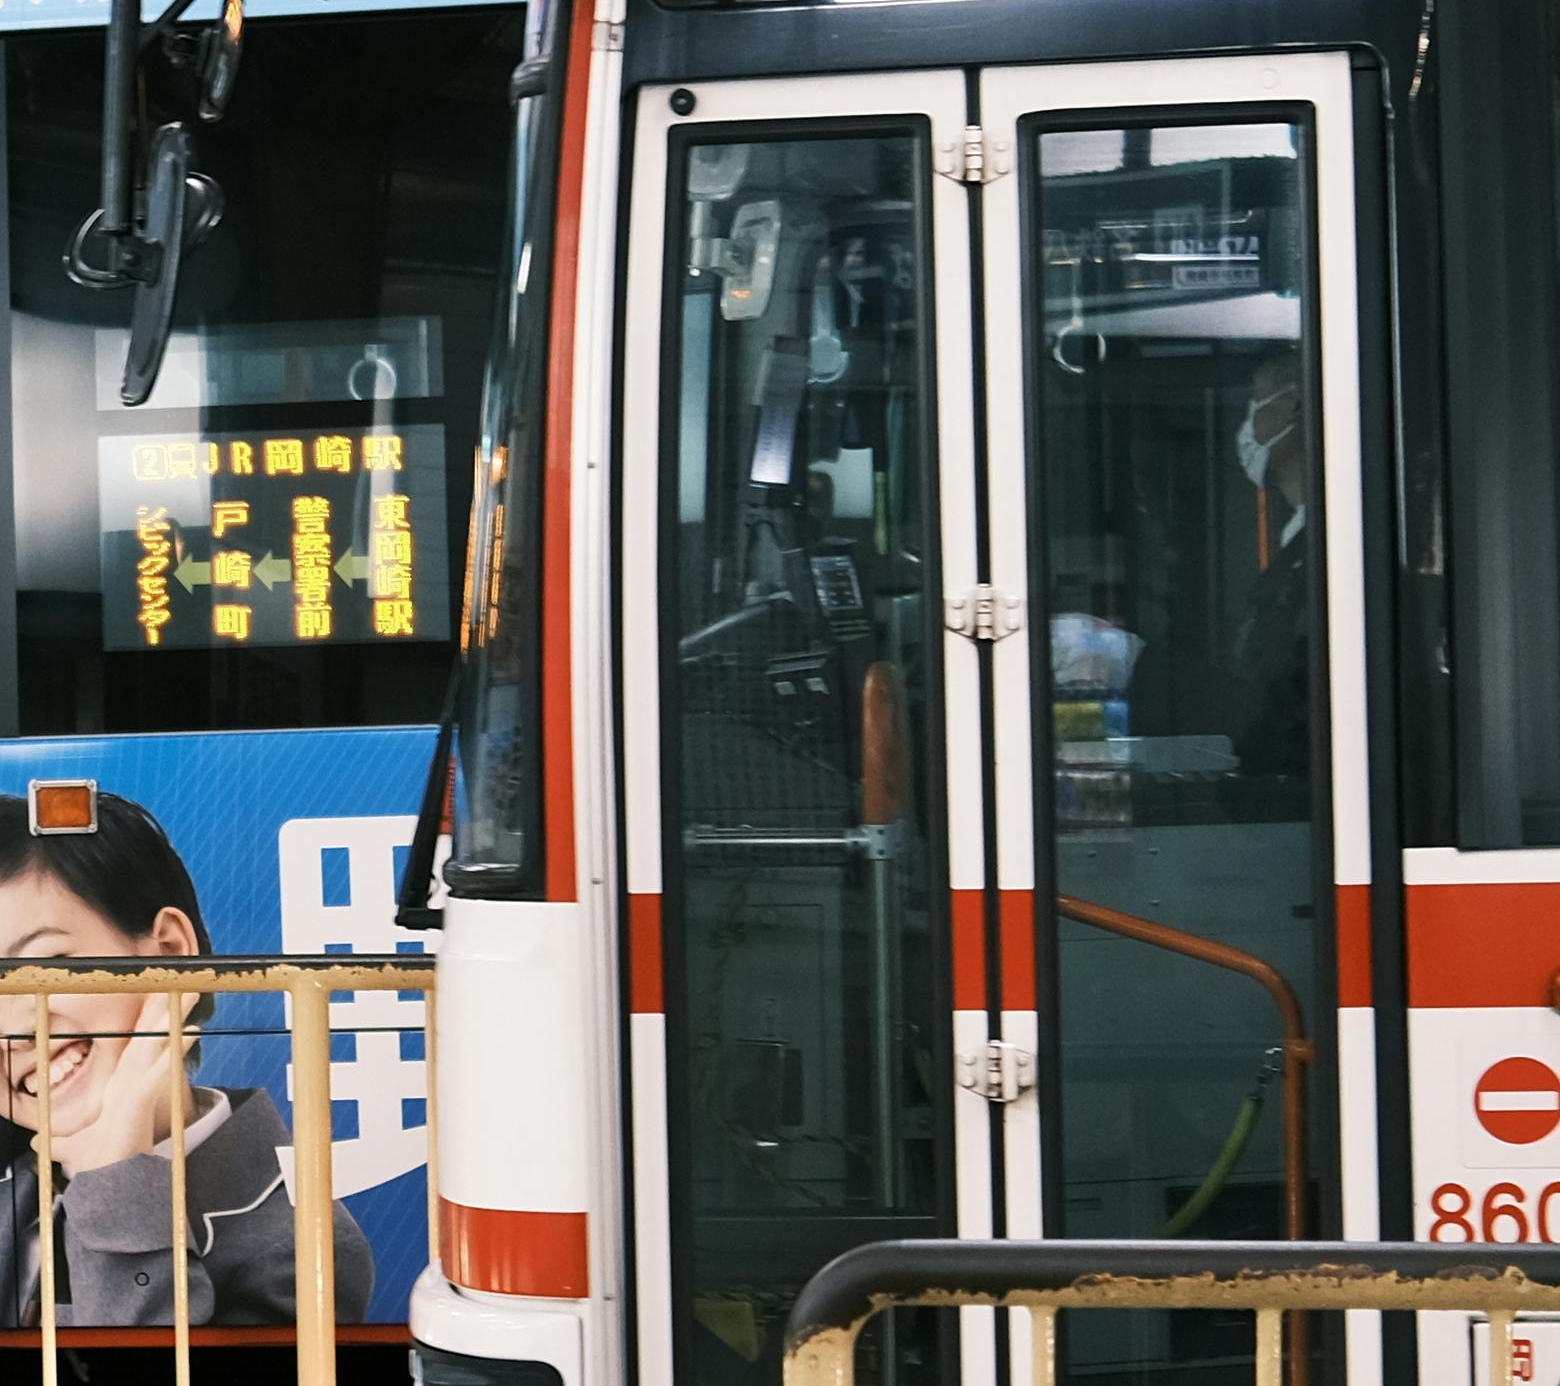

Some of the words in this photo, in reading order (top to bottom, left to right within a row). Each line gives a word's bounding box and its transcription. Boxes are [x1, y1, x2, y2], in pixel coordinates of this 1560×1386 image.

[212, 501, 253, 641] 戸崎町
[374, 494, 414, 636] 東岡崎駅
